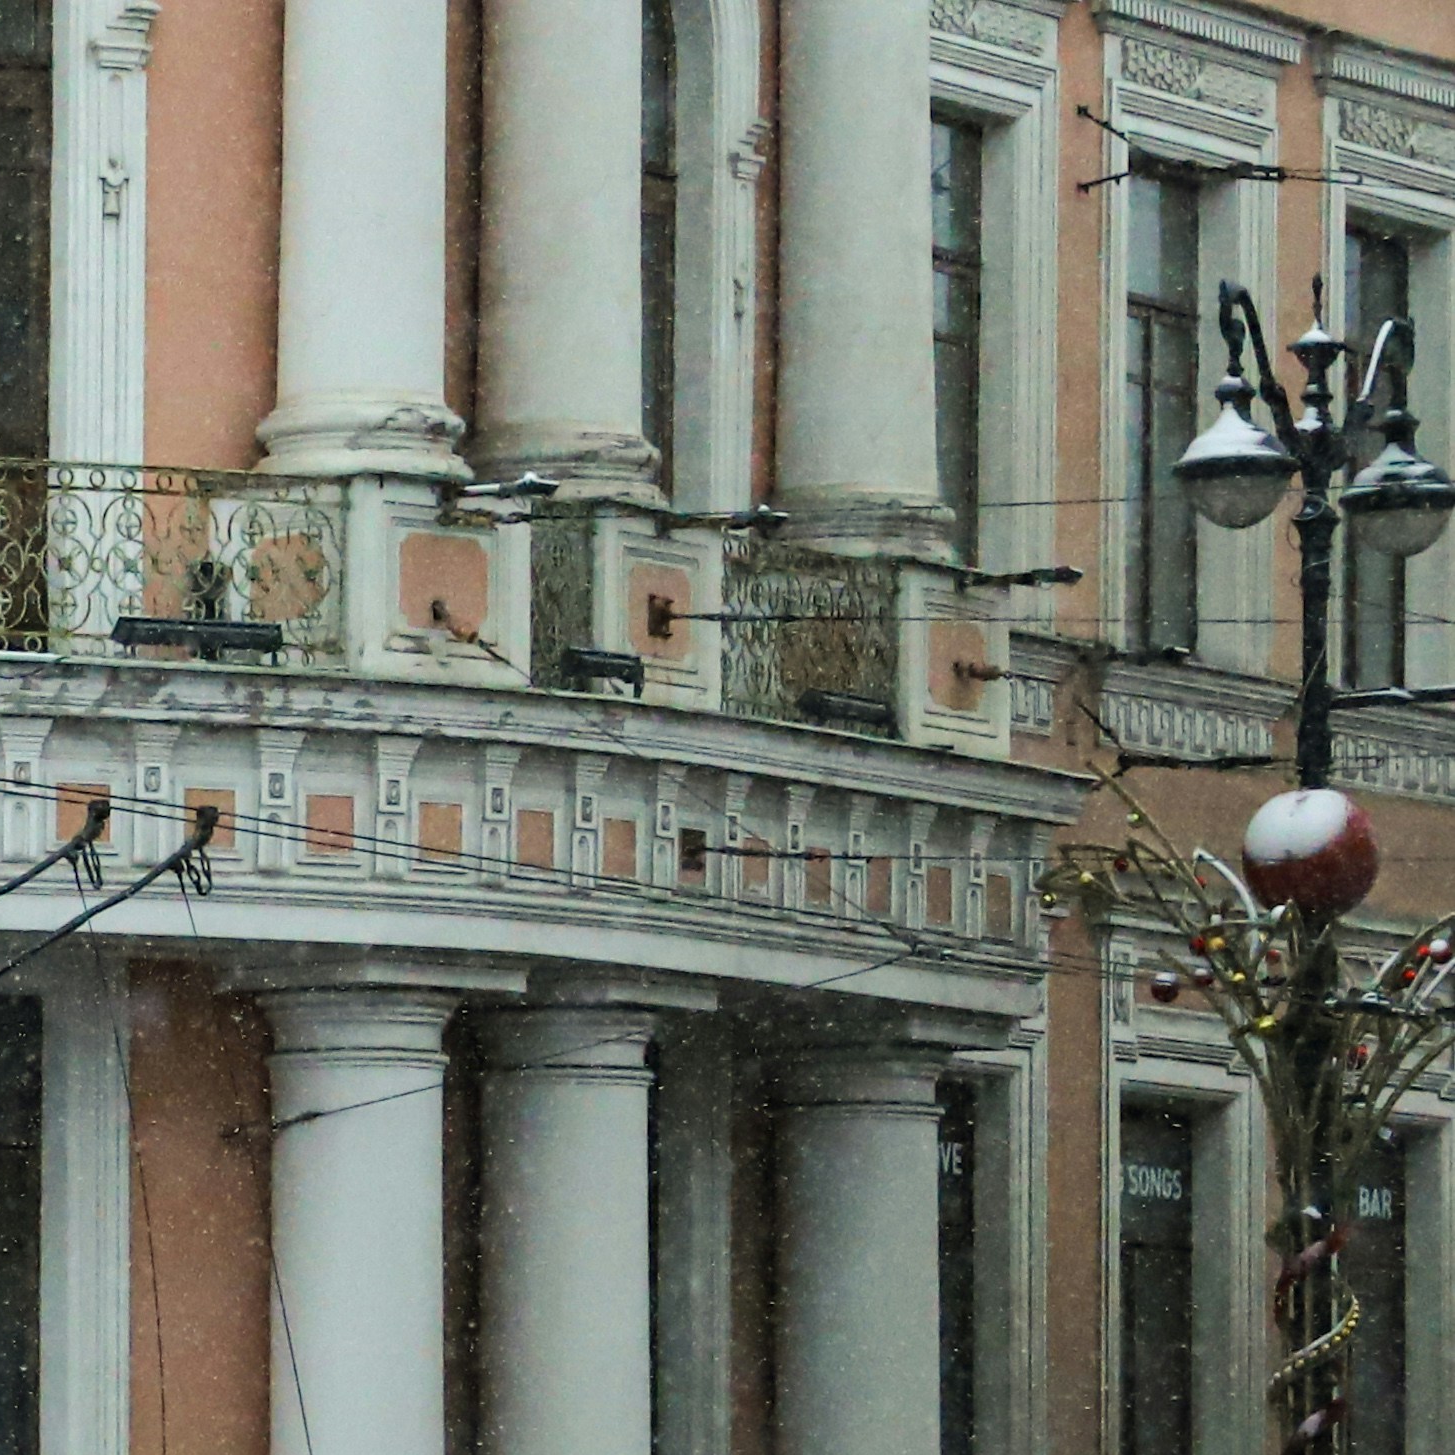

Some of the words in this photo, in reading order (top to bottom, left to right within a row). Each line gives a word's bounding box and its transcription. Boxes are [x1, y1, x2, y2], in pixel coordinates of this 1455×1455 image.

[940, 1142, 964, 1174] VE
[1128, 1164, 1182, 1200] SONGS
[1359, 1185, 1392, 1219] BAR
